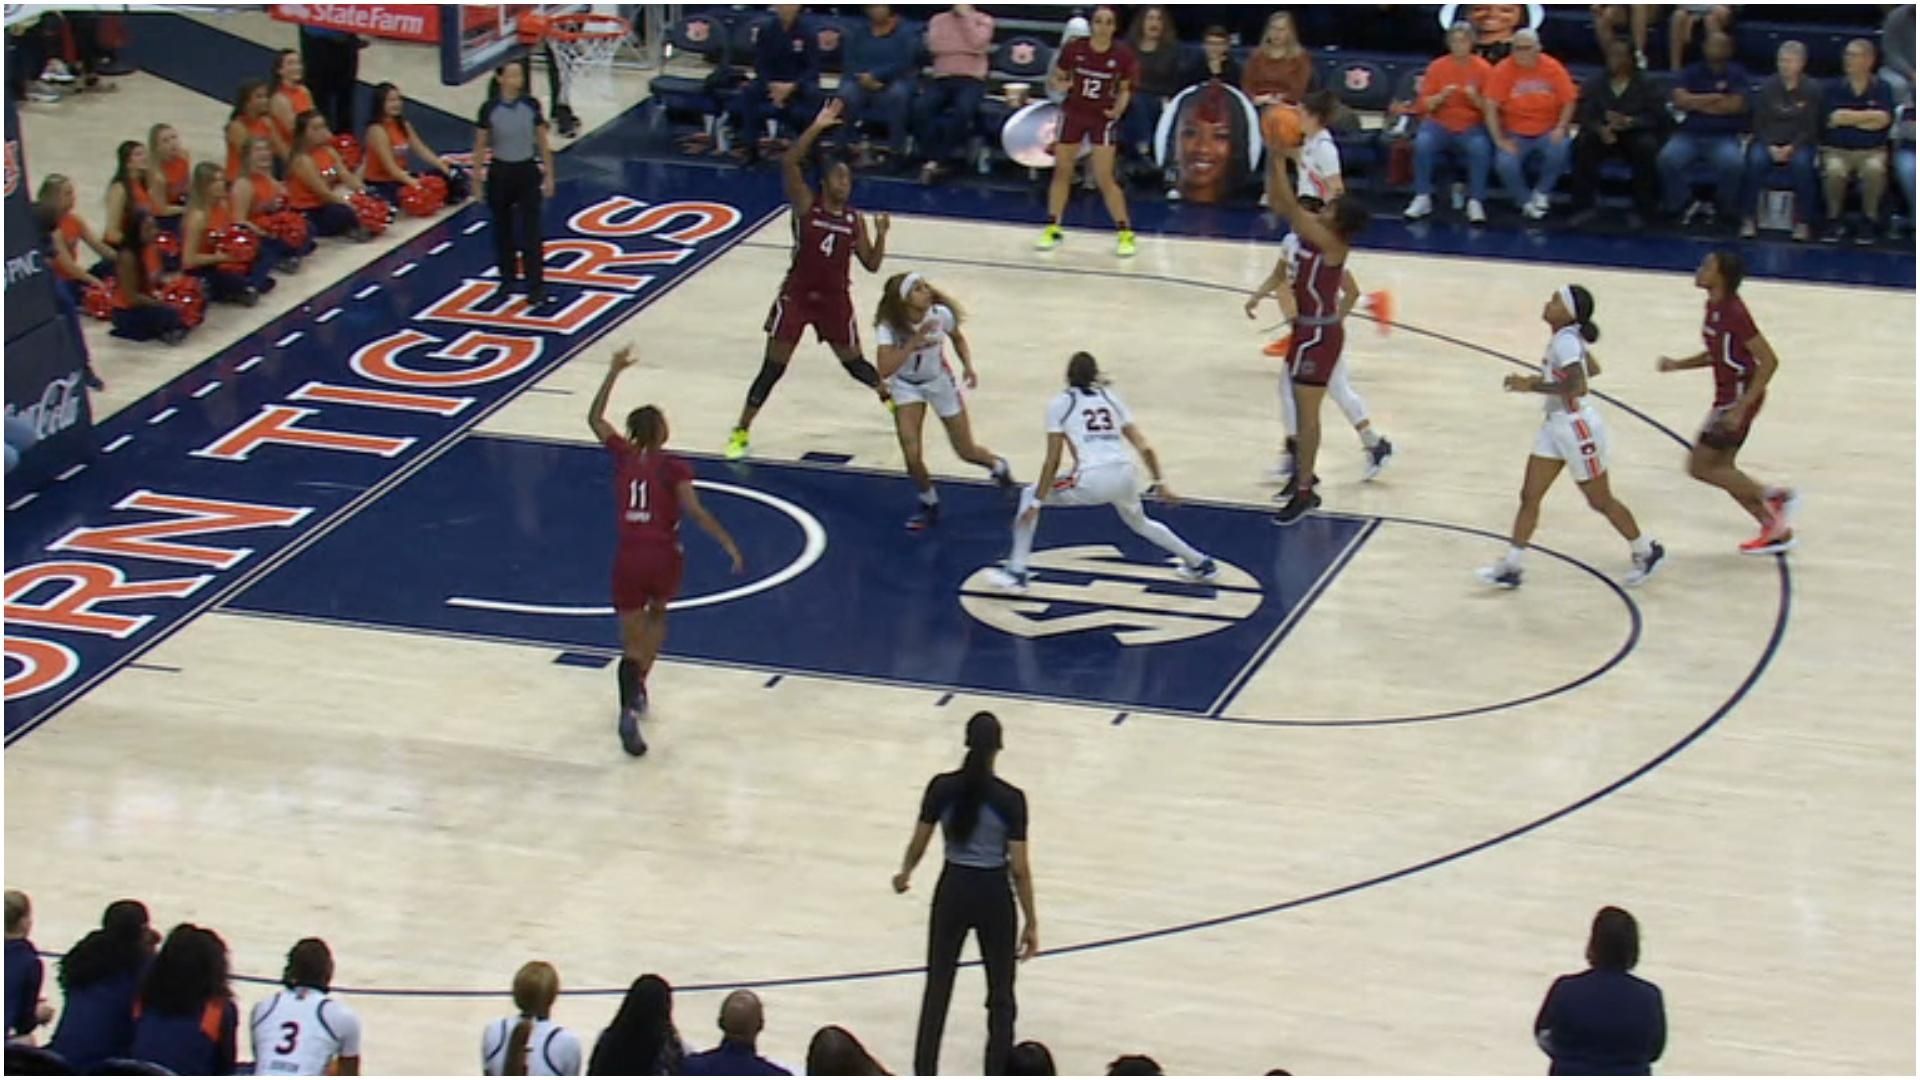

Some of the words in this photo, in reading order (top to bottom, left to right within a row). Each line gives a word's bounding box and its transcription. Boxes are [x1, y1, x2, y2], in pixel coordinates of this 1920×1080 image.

[1082, 78, 1102, 99] 12
[820, 232, 835, 257] 4
[190, 194, 742, 460] TIGERS
[1081, 406, 1115, 432] 23
[629, 478, 648, 510] 11
[274, 1020, 300, 1056] 3
